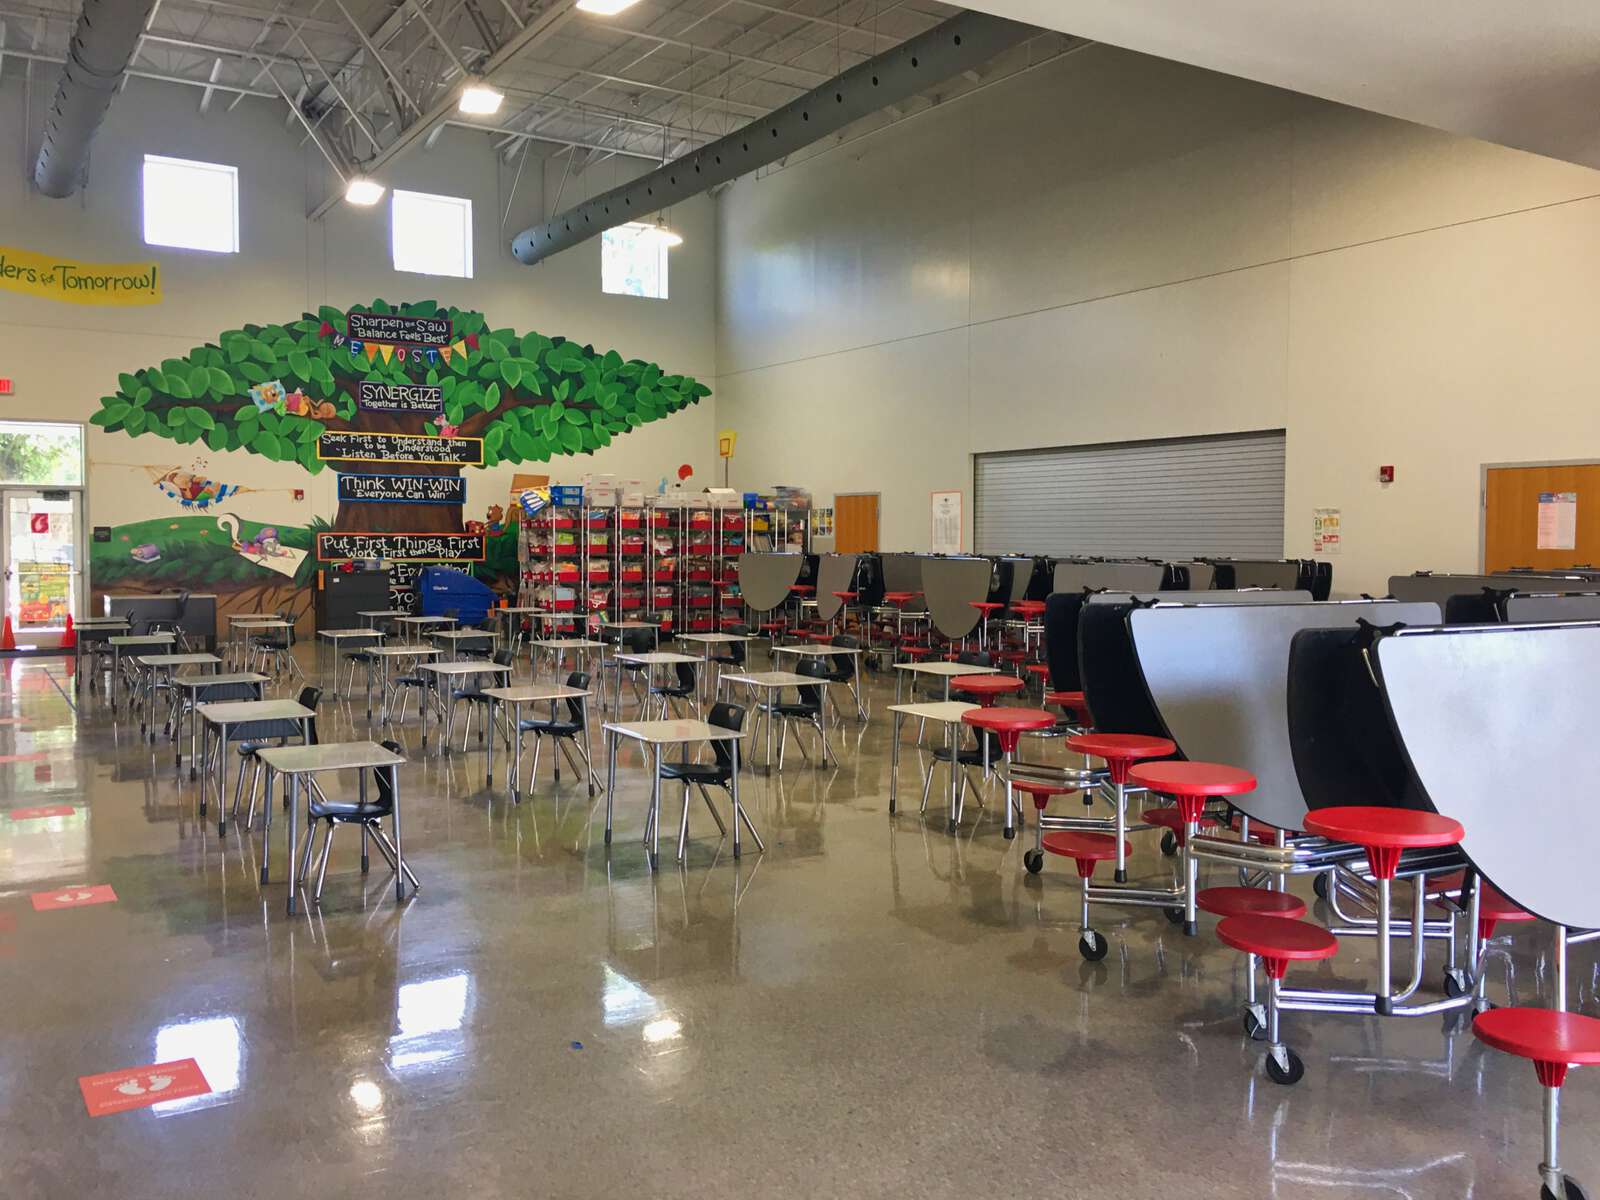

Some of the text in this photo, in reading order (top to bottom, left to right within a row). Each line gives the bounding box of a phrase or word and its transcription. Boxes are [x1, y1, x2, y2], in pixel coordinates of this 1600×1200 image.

[53, 265, 157, 295] Tomorrow!
[350, 314, 404, 330] Sharpen
[416, 319, 447, 333] Saw
[362, 384, 441, 402] SYNERGIZE
[401, 401, 408, 409] is
[321, 433, 467, 448] Seek First to Understand then
[364, 442, 374, 450] to
[397, 444, 451, 453] Understood
[381, 450, 414, 460] Before
[418, 452, 435, 462] You
[340, 476, 461, 492] Think WIN-WIN
[406, 490, 424, 499] Can
[321, 535, 480, 553] Put First Things First
[381, 548, 406, 558] First
